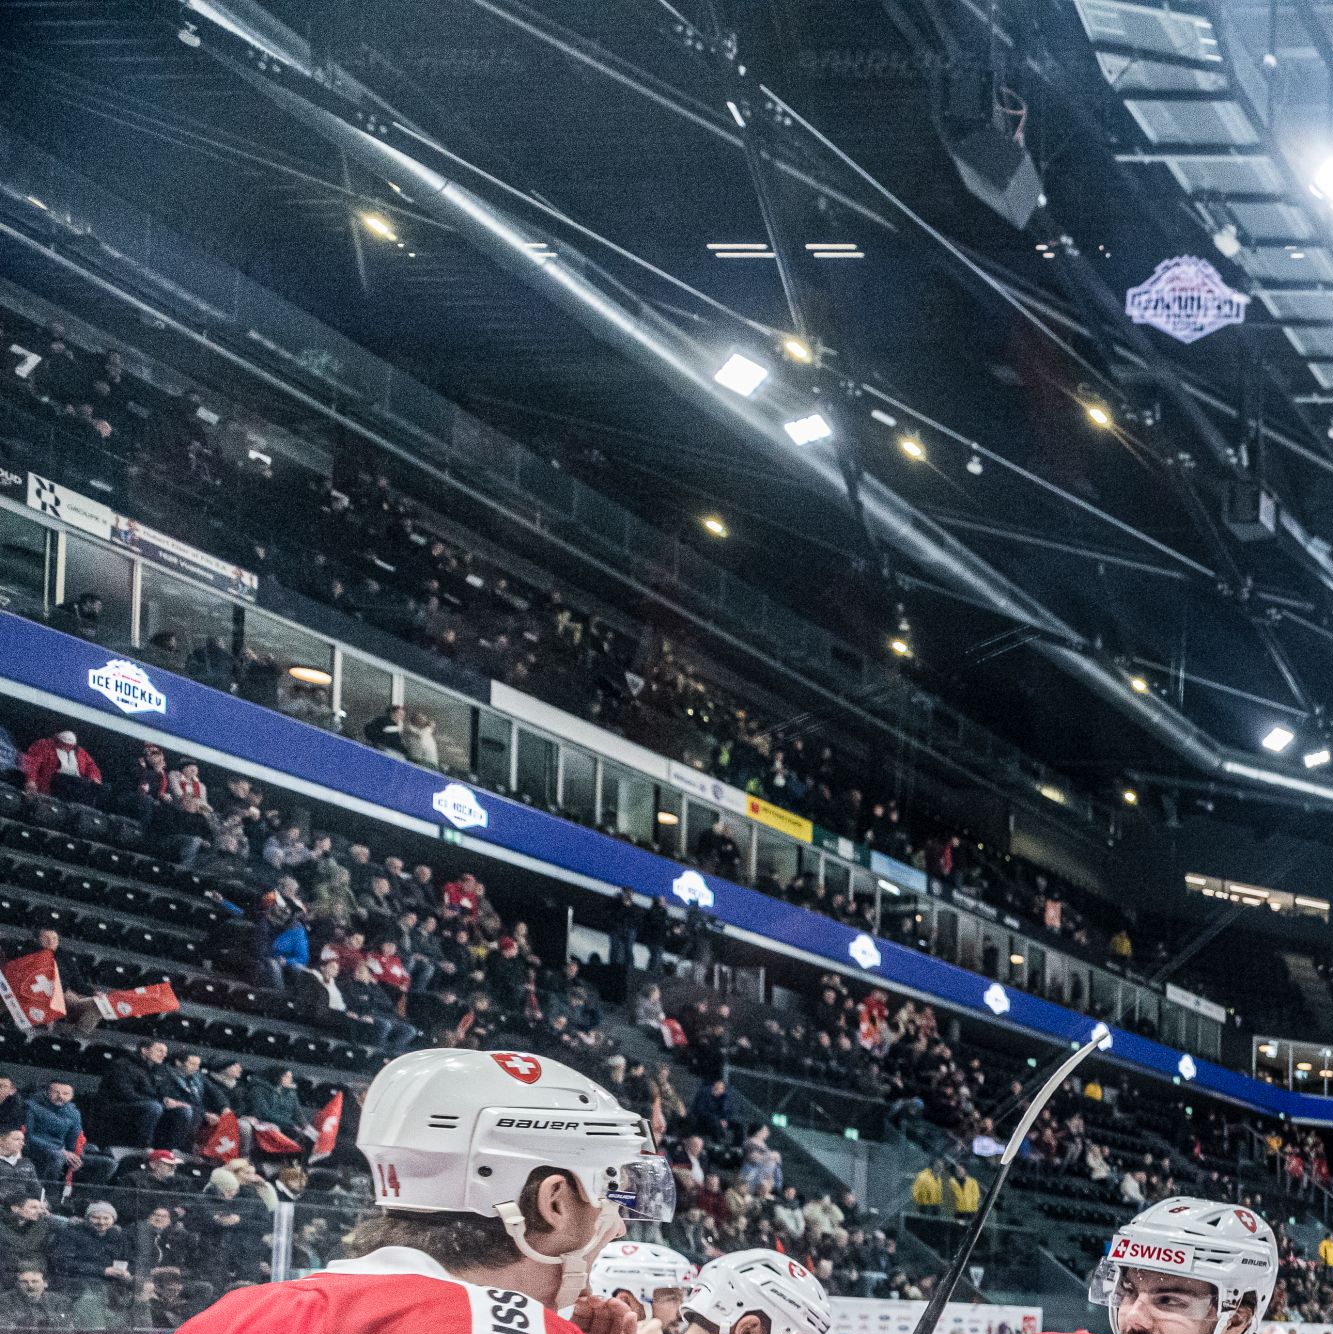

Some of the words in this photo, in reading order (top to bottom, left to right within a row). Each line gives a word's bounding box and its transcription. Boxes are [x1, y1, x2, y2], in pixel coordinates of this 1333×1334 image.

[92, 674, 111, 690] ICE
[115, 679, 162, 707] HOCKEY
[377, 1163, 401, 1197] 14
[1130, 1243, 1186, 1265] SWISS
